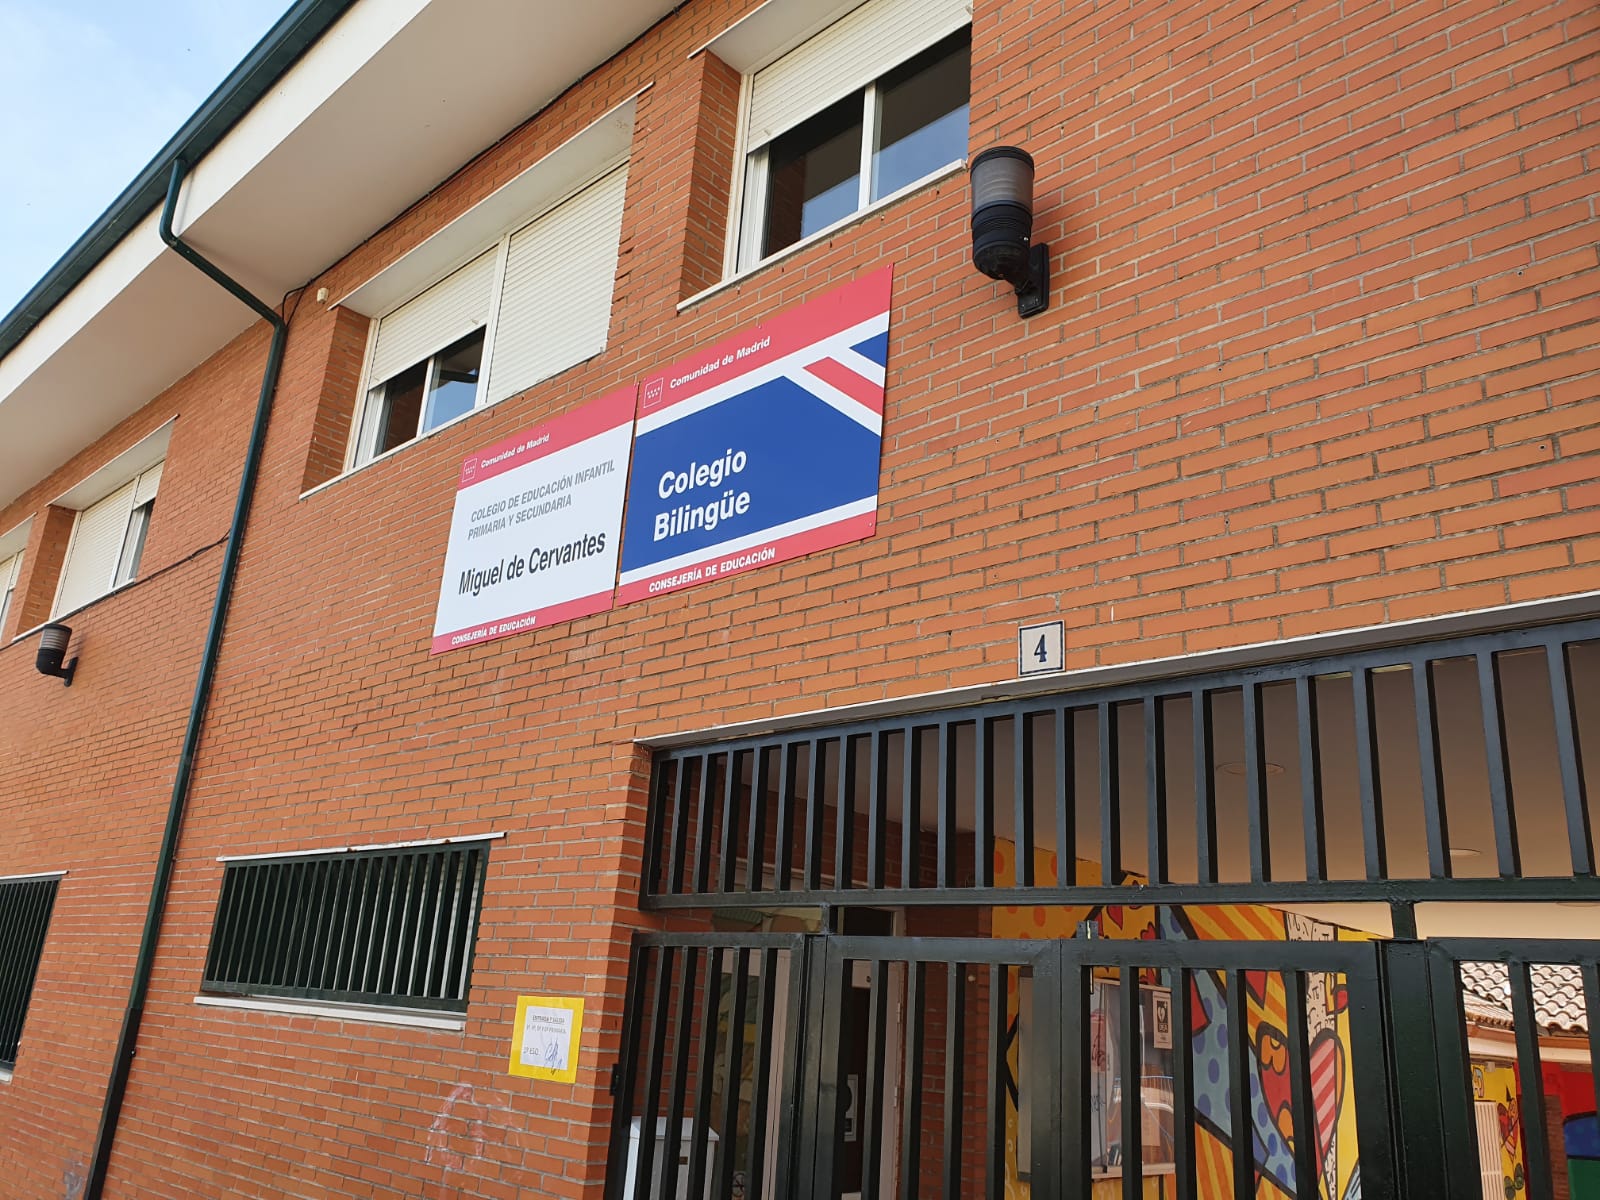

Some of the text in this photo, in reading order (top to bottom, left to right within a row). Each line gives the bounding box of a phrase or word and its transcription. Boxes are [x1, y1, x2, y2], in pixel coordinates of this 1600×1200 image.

[669, 336, 771, 389] Comunidad de Madrid
[480, 433, 550, 469] Comunidad de Madrid
[658, 448, 747, 499] Colegio
[471, 459, 615, 523] COLEGIO DE EDUCACIÓN INFANTIL
[653, 489, 751, 542] Bilingüe
[467, 494, 572, 541] PRIMARIA Y SECUNDARIA
[458, 532, 606, 597] Miguel de Cervantes
[649, 547, 776, 593] CONSEJERÍA DE EDUCACIÓN
[451, 615, 536, 645] CONSEJERÍA DE EDUCACIÓN
[1033, 633, 1047, 663] 4
